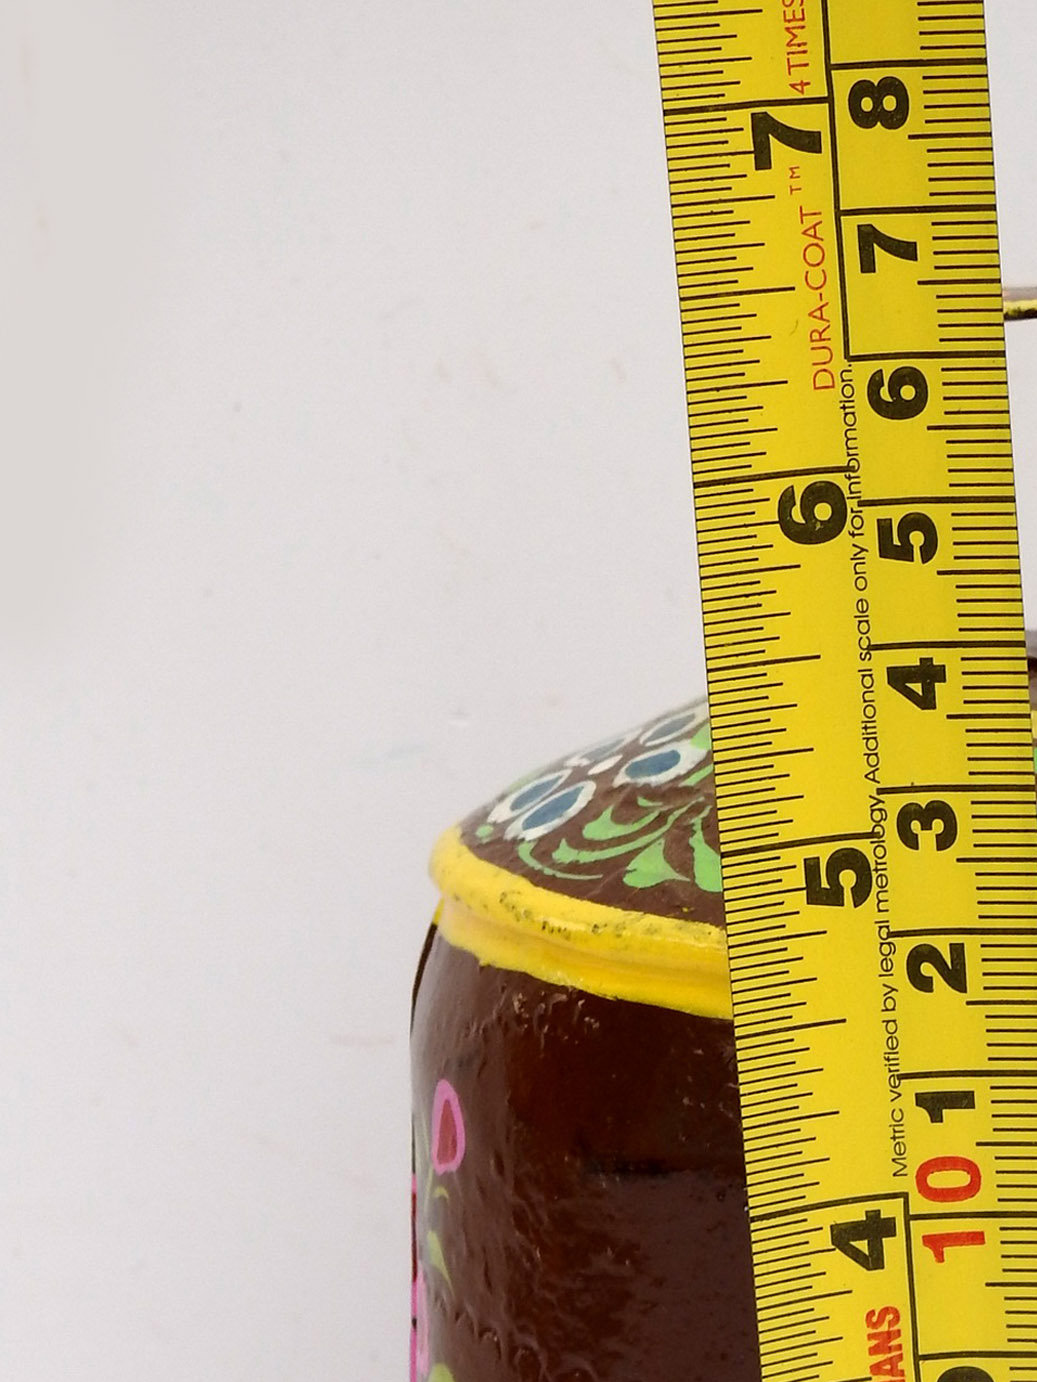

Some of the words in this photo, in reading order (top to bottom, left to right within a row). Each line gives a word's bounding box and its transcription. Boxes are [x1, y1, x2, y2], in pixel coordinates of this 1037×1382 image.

[848, 76, 910, 130] 8
[751, 111, 822, 171] 7
[857, 224, 918, 273] 7
[799, 205, 836, 390] DURA-COAT
[867, 366, 929, 421] 6
[838, 362, 862, 509] information.
[777, 480, 848, 545] 6
[847, 508, 865, 544] for
[876, 512, 938, 565] 5
[850, 543, 870, 593] only
[854, 598, 873, 662] scale
[886, 657, 947, 711] 4
[857, 668, 882, 784] Additional
[869, 794, 890, 914] metrology
[896, 800, 957, 851] 3
[803, 847, 873, 909] 5
[874, 919, 897, 978] legal
[906, 942, 968, 994] 2
[878, 982, 900, 1013] by
[881, 1018, 905, 1103] verified
[915, 1090, 976, 1124] 1
[889, 1107, 909, 1178] Metric
[830, 1209, 897, 1271] 4
